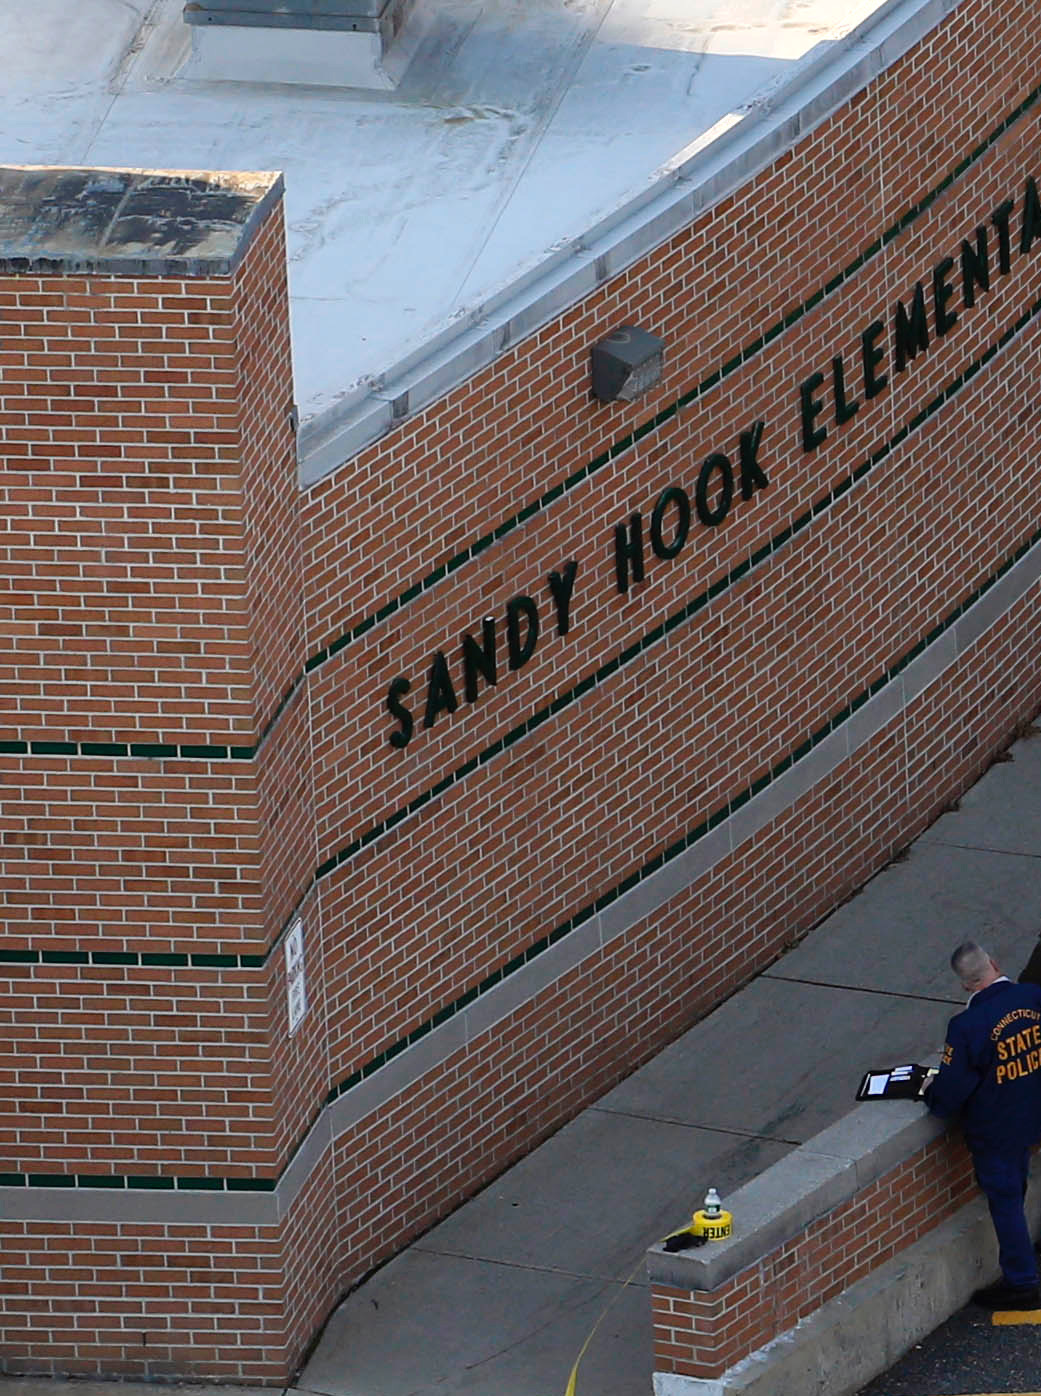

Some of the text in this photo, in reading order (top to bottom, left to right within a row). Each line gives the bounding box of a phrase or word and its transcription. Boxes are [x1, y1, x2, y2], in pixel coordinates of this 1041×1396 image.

[387, 561, 578, 749] SANDY
[614, 421, 769, 594] HOOK
[991, 1008, 1041, 1041] CONNECTICUT
[997, 1024, 1041, 1060] STATE
[703, 1224, 730, 1239] ENTER
